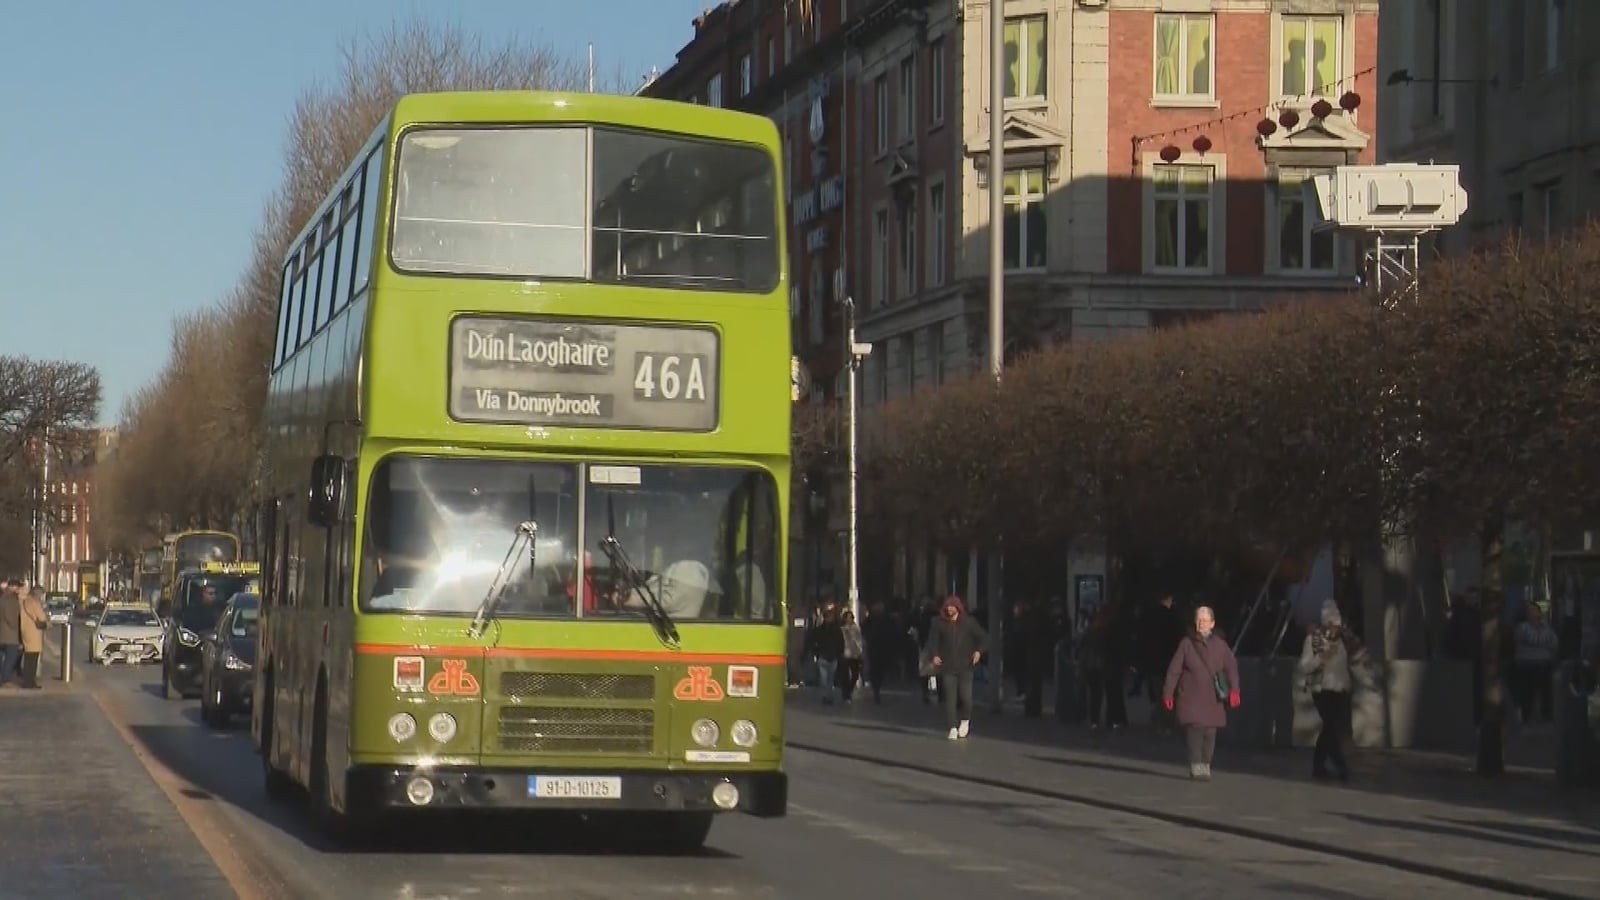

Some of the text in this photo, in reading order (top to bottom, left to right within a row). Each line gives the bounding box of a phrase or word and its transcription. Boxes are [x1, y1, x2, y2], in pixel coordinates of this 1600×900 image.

[467, 330, 609, 367] Dún Laoghaire
[634, 356, 705, 400] 46A
[476, 389, 601, 416] Via Donnybrook
